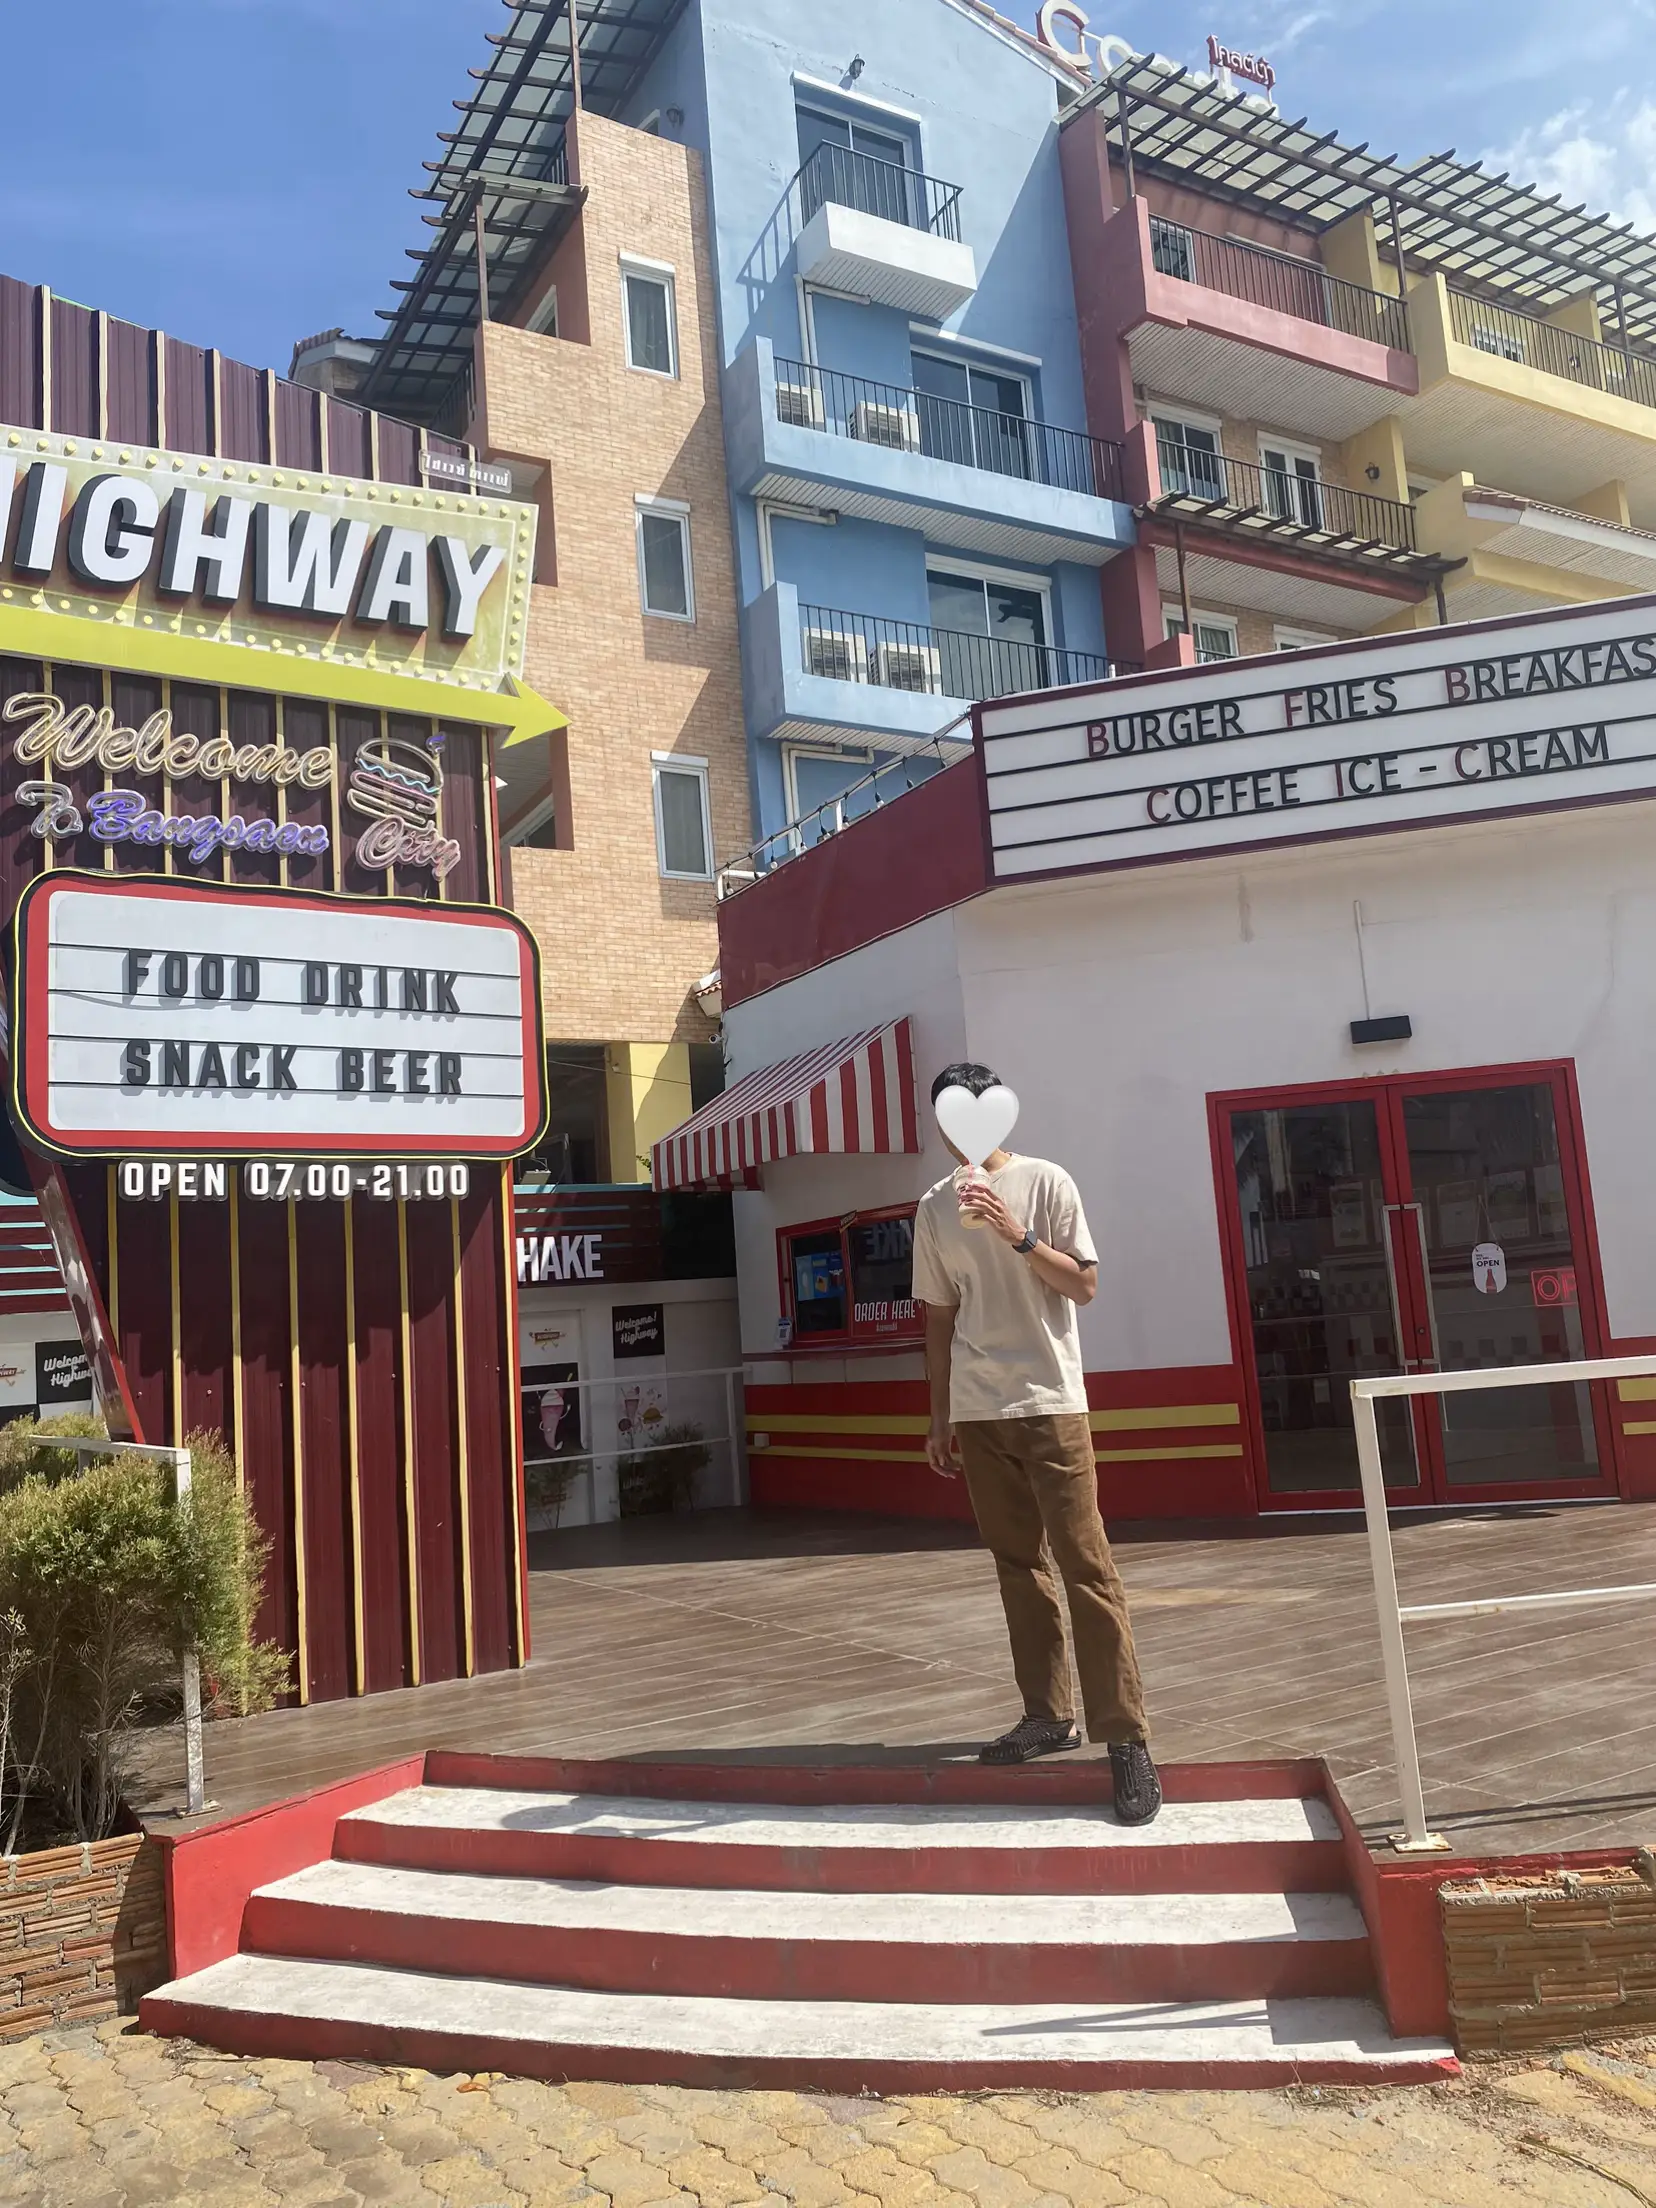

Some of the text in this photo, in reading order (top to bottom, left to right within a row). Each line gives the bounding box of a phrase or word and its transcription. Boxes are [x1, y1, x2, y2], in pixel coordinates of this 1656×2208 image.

[2, 692, 334, 790] Welcome
[1086, 702, 1244, 758] BURGER
[1284, 676, 1397, 728] FRIES
[1146, 767, 1300, 825] COFFEE
[1335, 755, 1399, 798] ICE
[1454, 723, 1610, 782] CREAM
[15, 781, 461, 882] To Bangsaen City
[128, 948, 462, 1014] FOOD DRINK
[127, 1039, 462, 1095] SNACK BEER
[122, 1162, 470, 1198] OPEN 07.00-21.00
[516, 1234, 604, 1282] HAKE
[1476, 1259, 1500, 1267] OPEN
[854, 1299, 916, 1322] ORDER HERE
